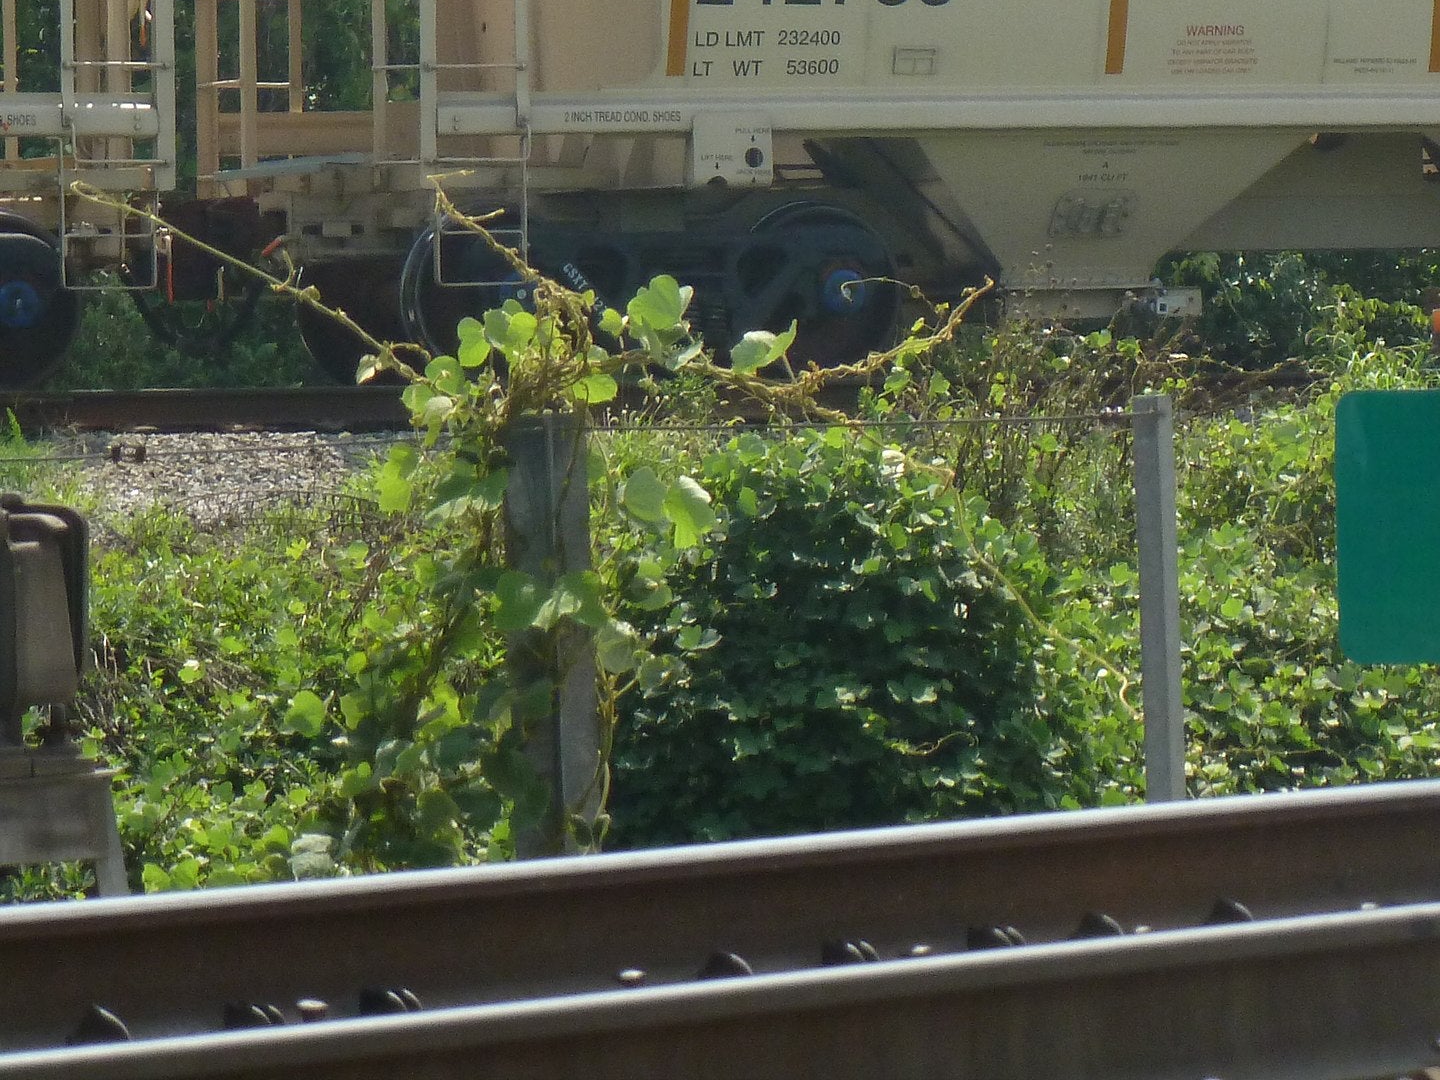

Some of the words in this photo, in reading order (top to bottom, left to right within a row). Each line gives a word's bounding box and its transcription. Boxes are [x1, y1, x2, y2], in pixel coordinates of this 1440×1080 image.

[694, 31, 719, 47] LD
[725, 30, 765, 47] LMT
[777, 29, 841, 46] 232400
[1186, 24, 1245, 37] WARNING
[692, 60, 714, 77] LT
[732, 59, 763, 77] WT
[786, 58, 839, 75] 53600
[652, 111, 682, 122] SHOES
[563, 263, 588, 289] CSXT
